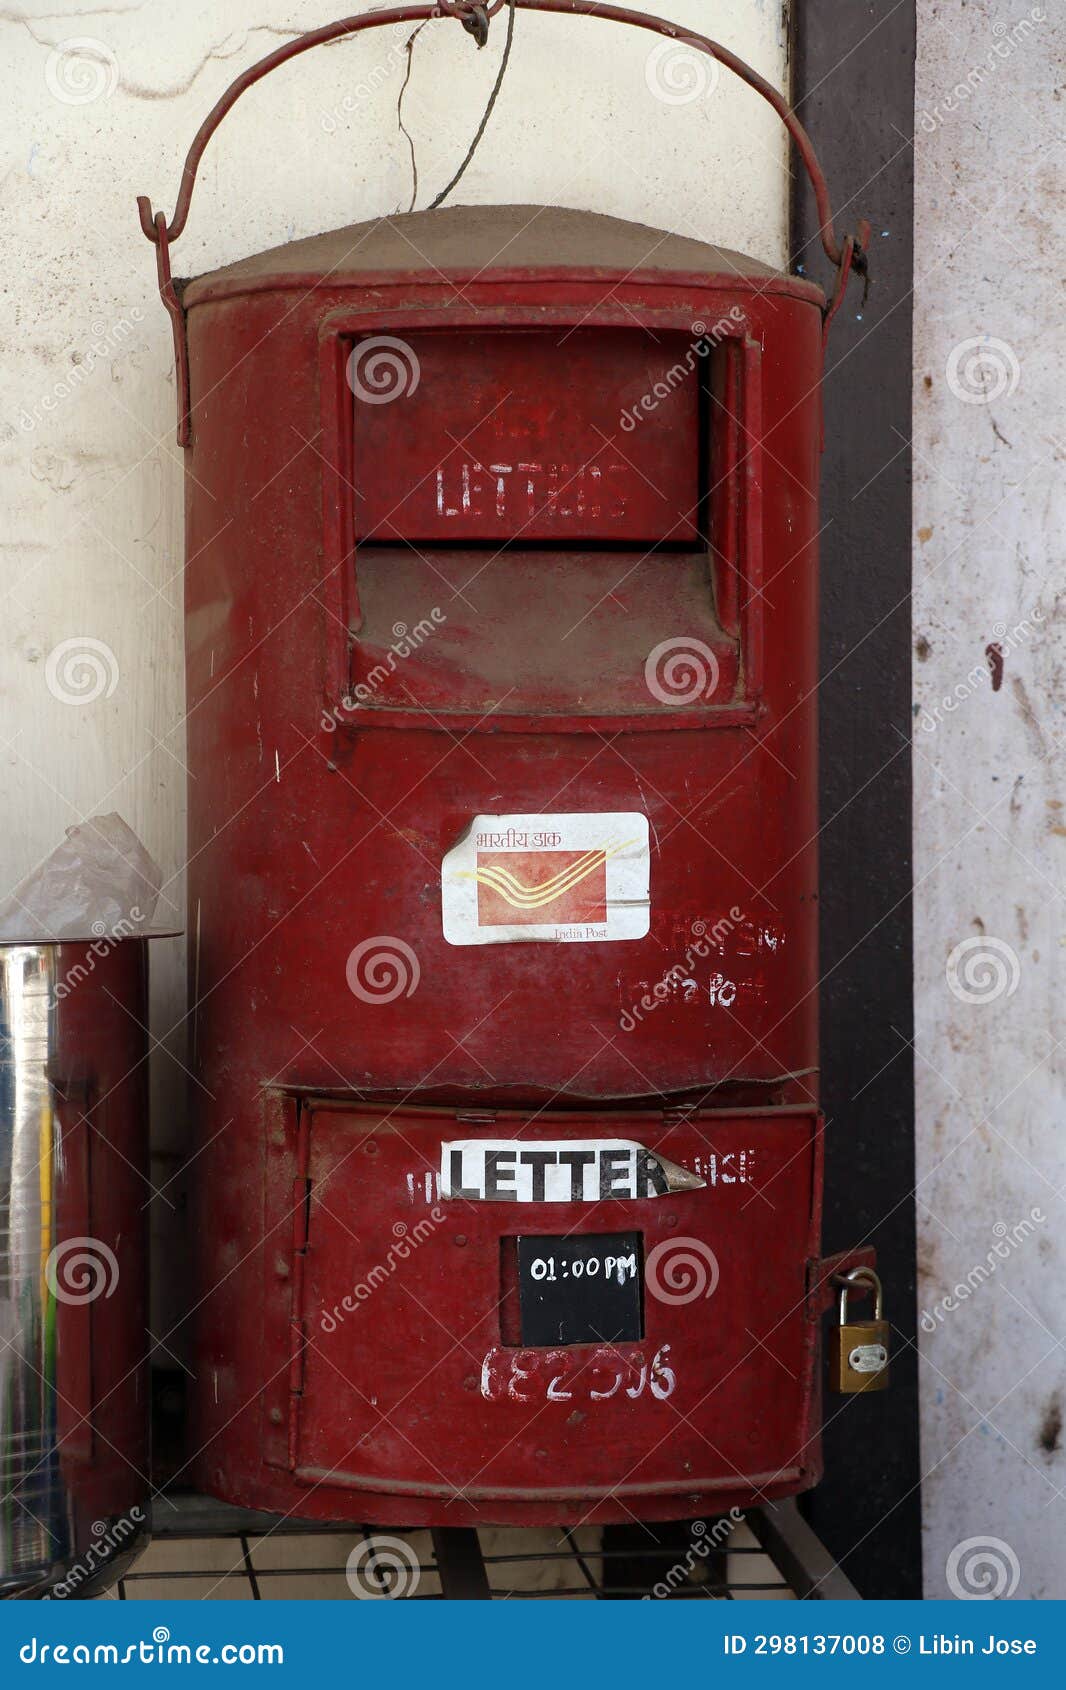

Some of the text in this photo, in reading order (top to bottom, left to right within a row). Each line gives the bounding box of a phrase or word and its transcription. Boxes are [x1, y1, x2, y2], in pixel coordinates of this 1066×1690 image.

[476, 828, 562, 848] भारतीय डाक
[554, 927, 609, 940] India Post
[449, 1149, 671, 1202] LETTER
